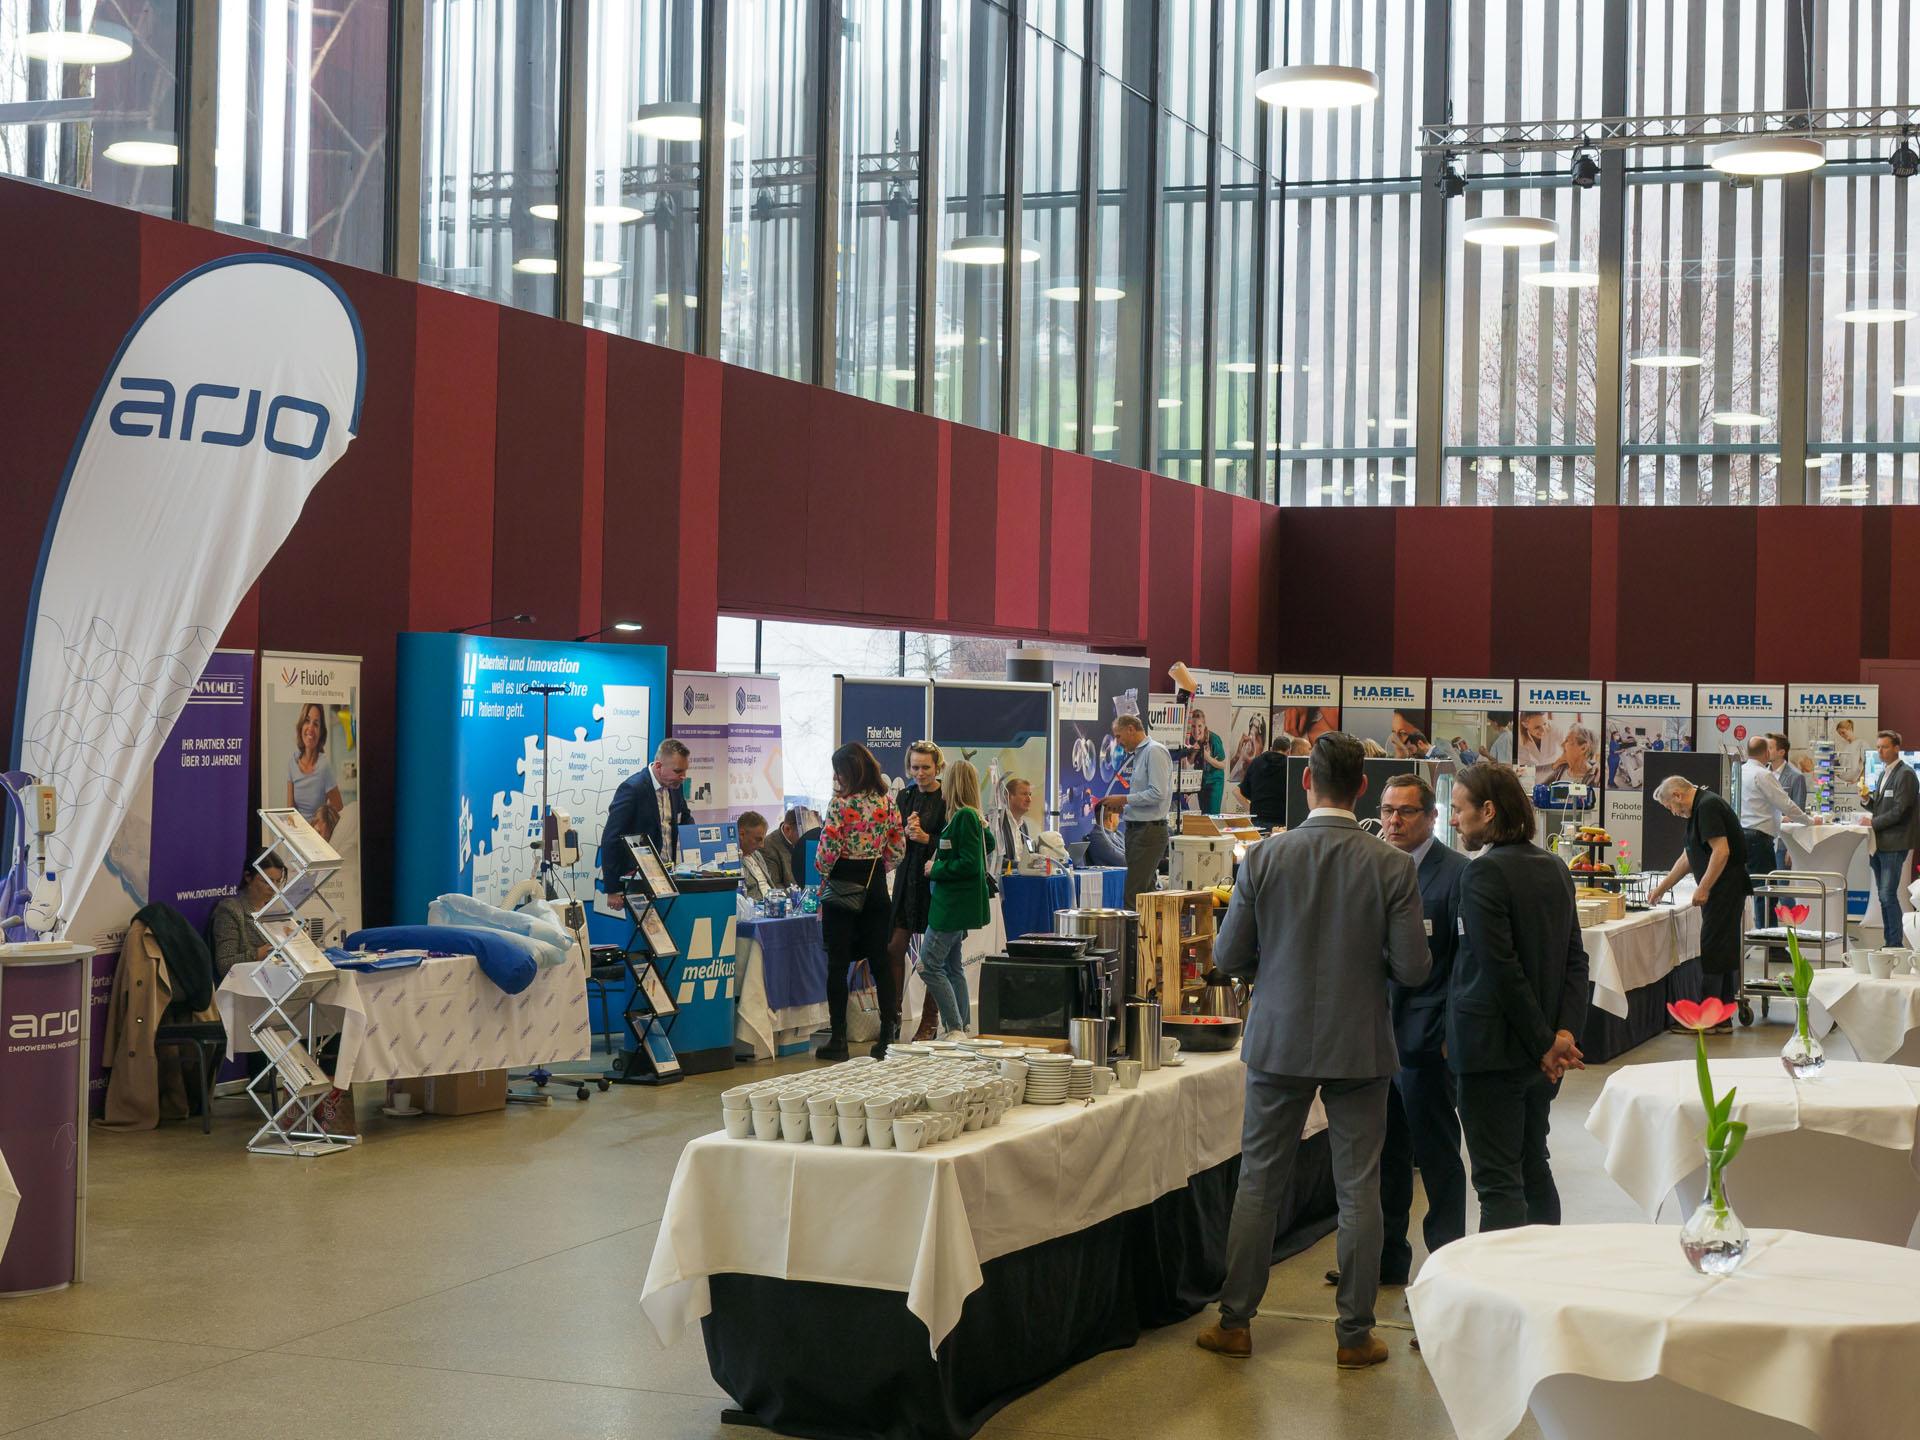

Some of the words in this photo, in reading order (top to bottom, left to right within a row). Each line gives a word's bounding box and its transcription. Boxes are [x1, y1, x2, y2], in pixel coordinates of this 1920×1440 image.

[109, 376, 330, 461] arjo
[478, 654, 508, 670] Sicherheit
[510, 656, 525, 671] und
[527, 656, 580, 673] Innovation
[194, 681, 237, 694] NOVOMED
[505, 682, 514, 695] es
[567, 682, 588, 696] Ihre
[1058, 666, 1099, 704] edCARE
[1210, 681, 1230, 693] HABEL
[1237, 684, 1266, 695] HABEL
[1282, 684, 1331, 695] HABEL
[1353, 686, 1415, 697] HABEL
[1442, 688, 1503, 700] HABEL
[1530, 689, 1591, 701] HABEL
[1617, 693, 1681, 705] HABEL
[1708, 694, 1773, 706] HABEL
[1800, 694, 1867, 705] HABEL
[478, 701, 505, 717] Patienten
[506, 703, 525, 720] geht.
[182, 738, 194, 750] IHR
[195, 738, 225, 750] PARTNER
[227, 738, 243, 749] SEIT
[181, 753, 200, 767] ÜBER
[201, 755, 210, 766] 30
[211, 754, 242, 766] JAHREN!
[608, 757, 640, 765] Customized
[176, 884, 238, 901] www.novomed.at
[683, 959, 736, 980] medikus
[9, 1009, 79, 1039] arjo
[8, 1042, 57, 1053] EMPOWERING
